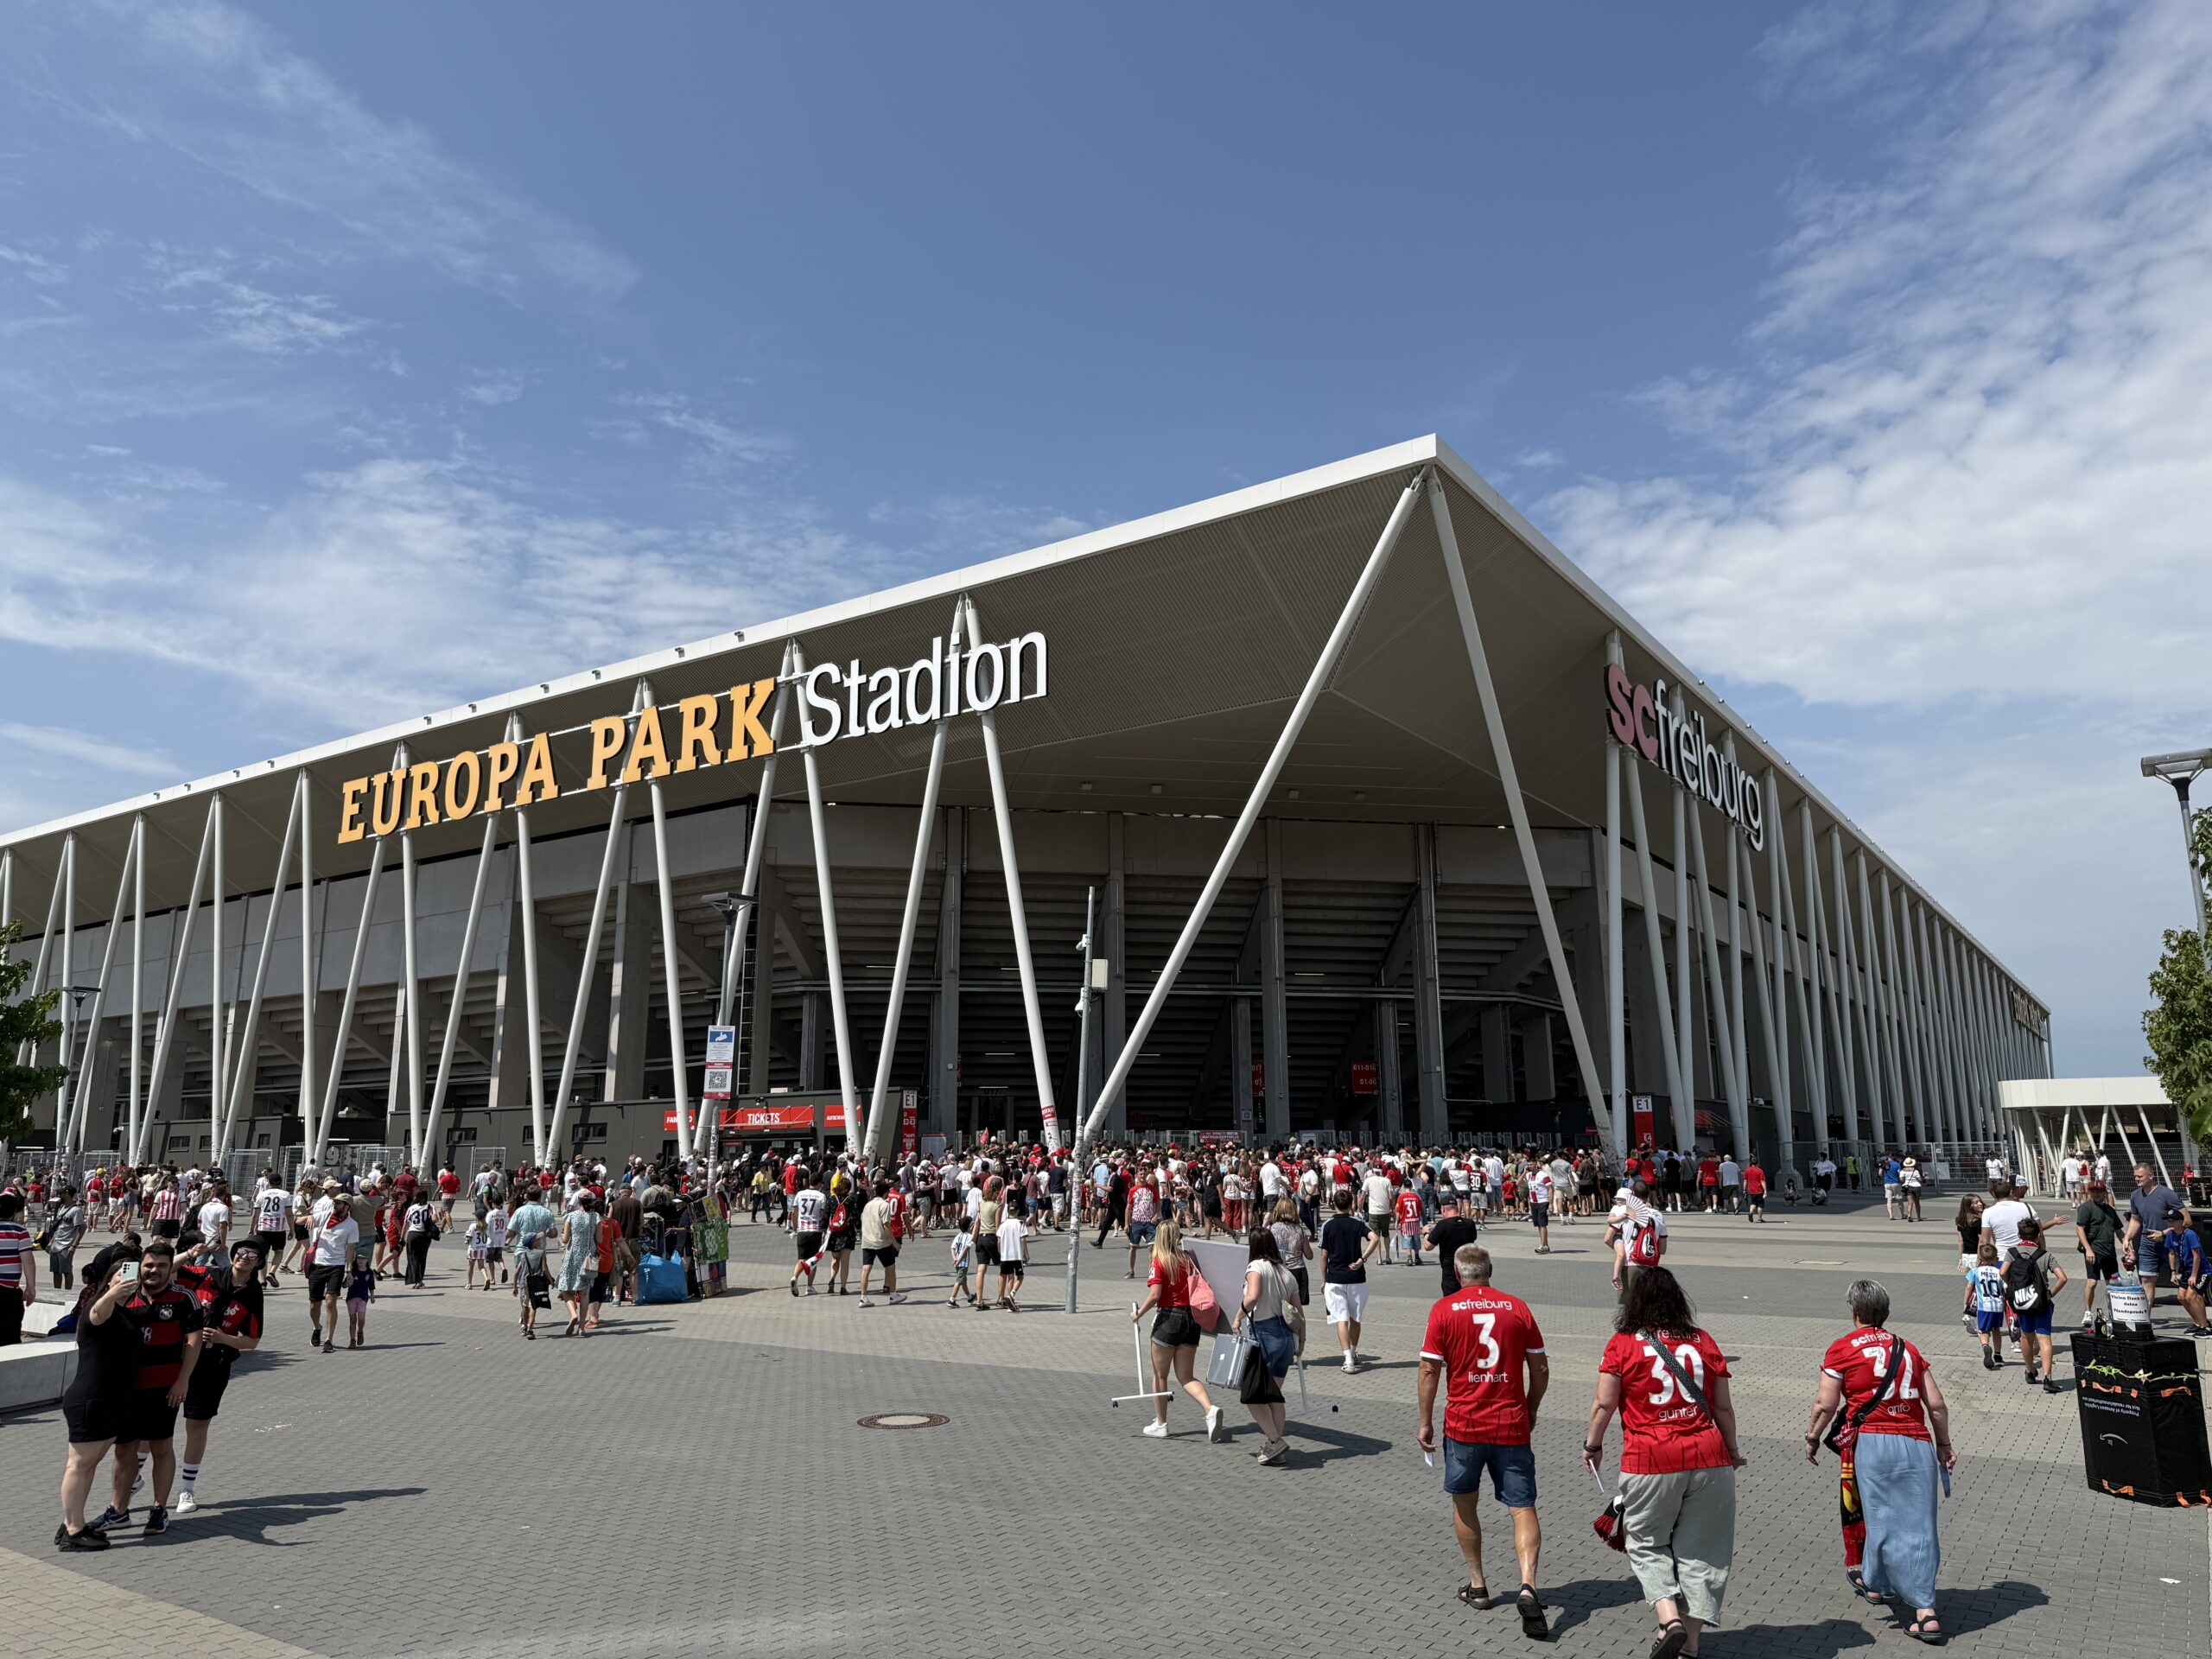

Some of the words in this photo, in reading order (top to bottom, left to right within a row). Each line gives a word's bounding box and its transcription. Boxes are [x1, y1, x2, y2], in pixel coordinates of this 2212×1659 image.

[338, 732, 560, 844] EUROPA
[588, 677, 776, 790] PARK
[804, 631, 1047, 746] Stadion
[905, 1094, 915, 1106] E1
[1636, 1099, 1649, 1109] E1
[747, 1112, 780, 1125] TICKETS
[1469, 1175, 1481, 1187] 30
[264, 1196, 281, 1212] 28
[800, 1198, 817, 1216] 37
[1404, 1200, 1418, 1217] 31
[494, 1218, 505, 1230] 30
[476, 1232, 488, 1244] 30
[1980, 1278, 2000, 1298] 10
[1452, 1299, 1513, 1311] scfreiburg
[1472, 1313, 1500, 1369] 3
[1468, 1370, 1509, 1383] lienhart
[1643, 1344, 1704, 1405] 30
[1887, 1402, 1911, 1416] grifo
